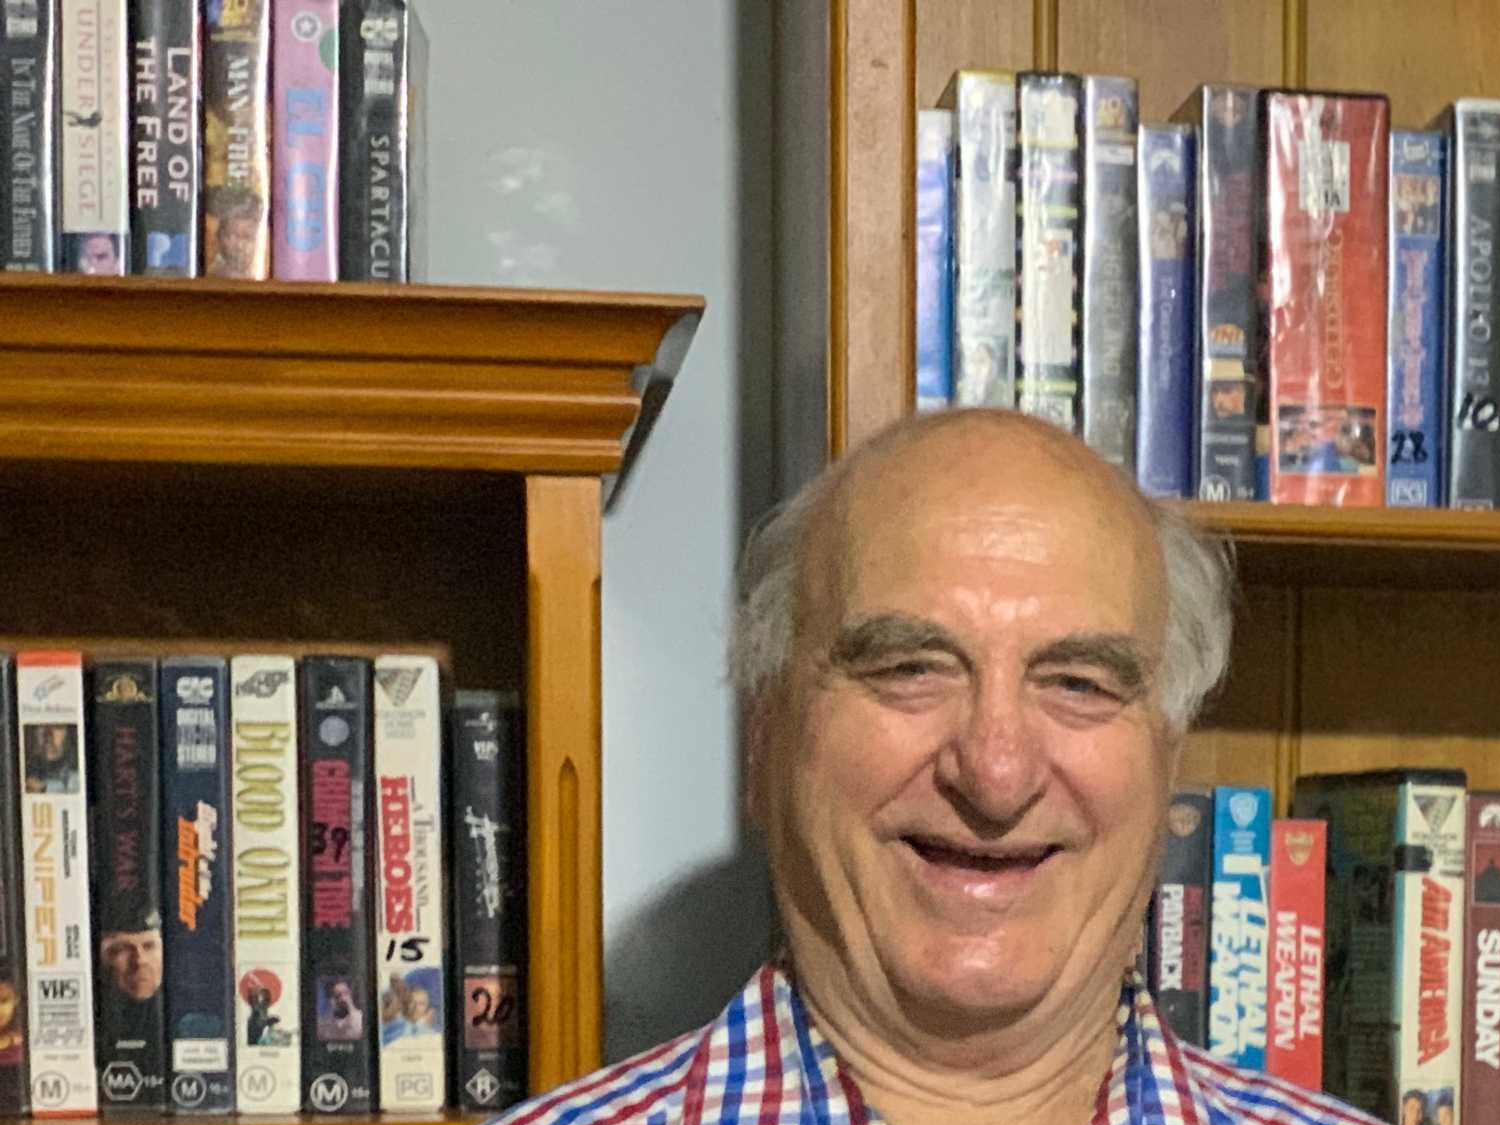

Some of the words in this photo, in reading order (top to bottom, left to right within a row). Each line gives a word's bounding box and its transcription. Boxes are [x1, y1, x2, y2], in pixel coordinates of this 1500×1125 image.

[77, 9, 95, 112] UNDER
[136, 38, 156, 103] THE
[167, 47, 192, 145] LAND
[79, 135, 95, 214] SIEGE
[136, 116, 160, 210] FREE
[168, 154, 189, 202] OF
[370, 134, 390, 278] SPARTACU
[237, 720, 291, 832] BLOOD
[30, 801, 57, 966] SNIPER
[237, 846, 291, 941] OATH
[380, 774, 413, 934] HEROES
[386, 936, 430, 963] 15
[1159, 883, 1185, 992] PAYBACK
[1239, 899, 1266, 1054] LETHAL
[1274, 911, 1296, 1051] WEAPON
[1299, 924, 1322, 1040] LETHAL
[1417, 932, 1450, 1067] AMERICA
